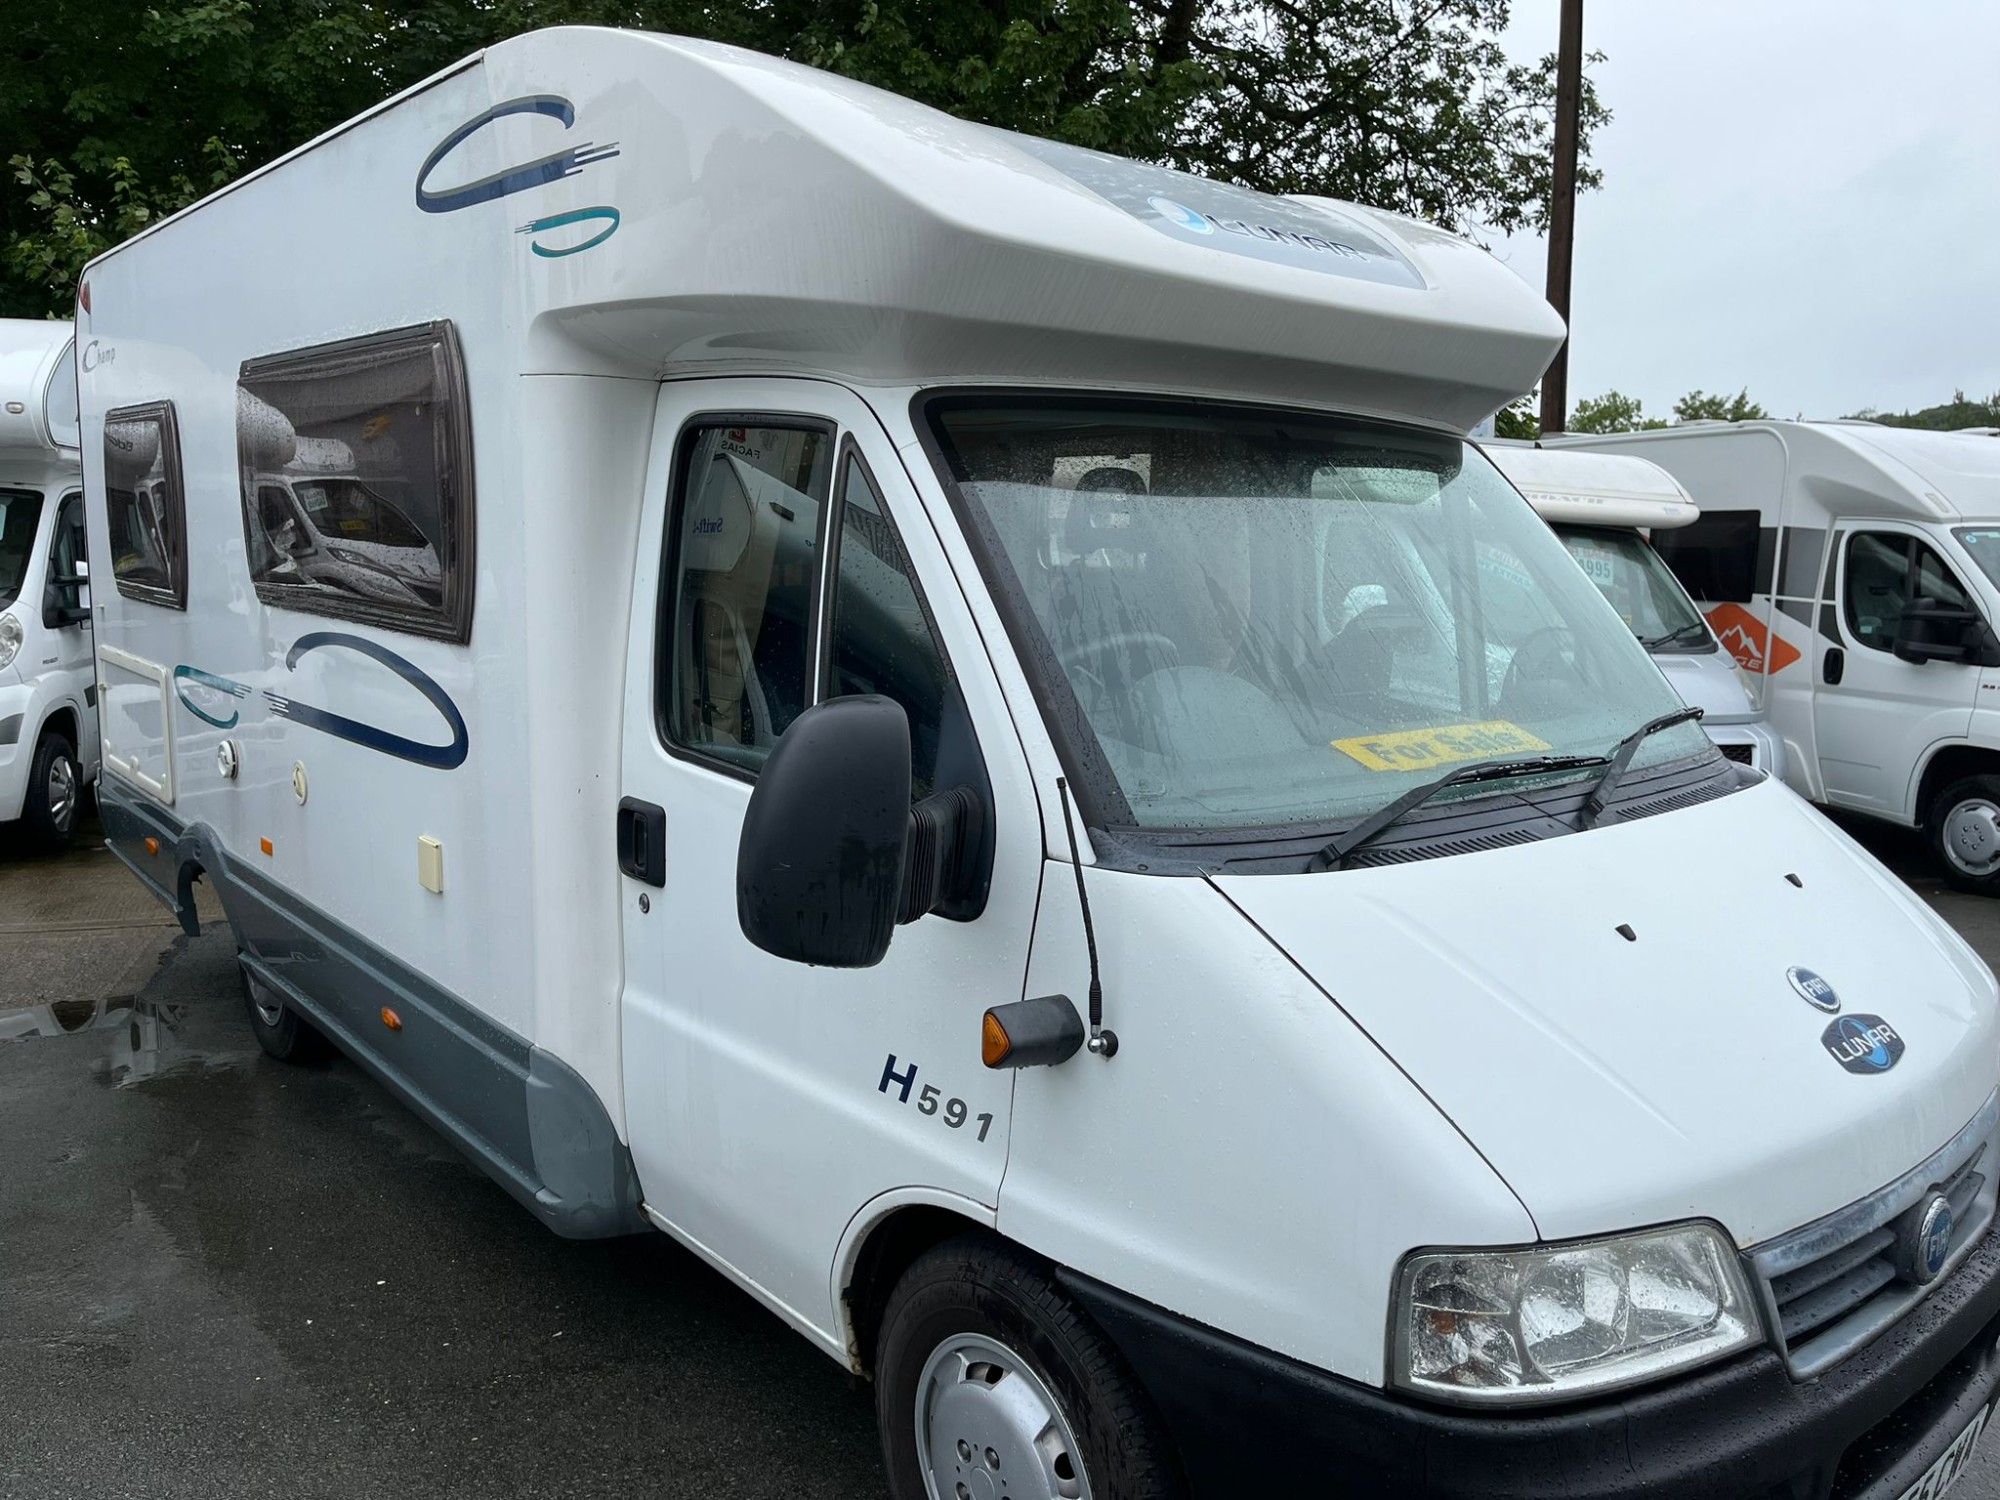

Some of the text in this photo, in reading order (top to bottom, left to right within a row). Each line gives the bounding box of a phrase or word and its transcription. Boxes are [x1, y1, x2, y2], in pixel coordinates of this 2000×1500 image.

[1204, 213, 1370, 262] LUNAR
[1360, 728, 1525, 764] For Sale
[1801, 977, 1831, 997] FIAT
[1830, 1024, 1897, 1063] LUNAR
